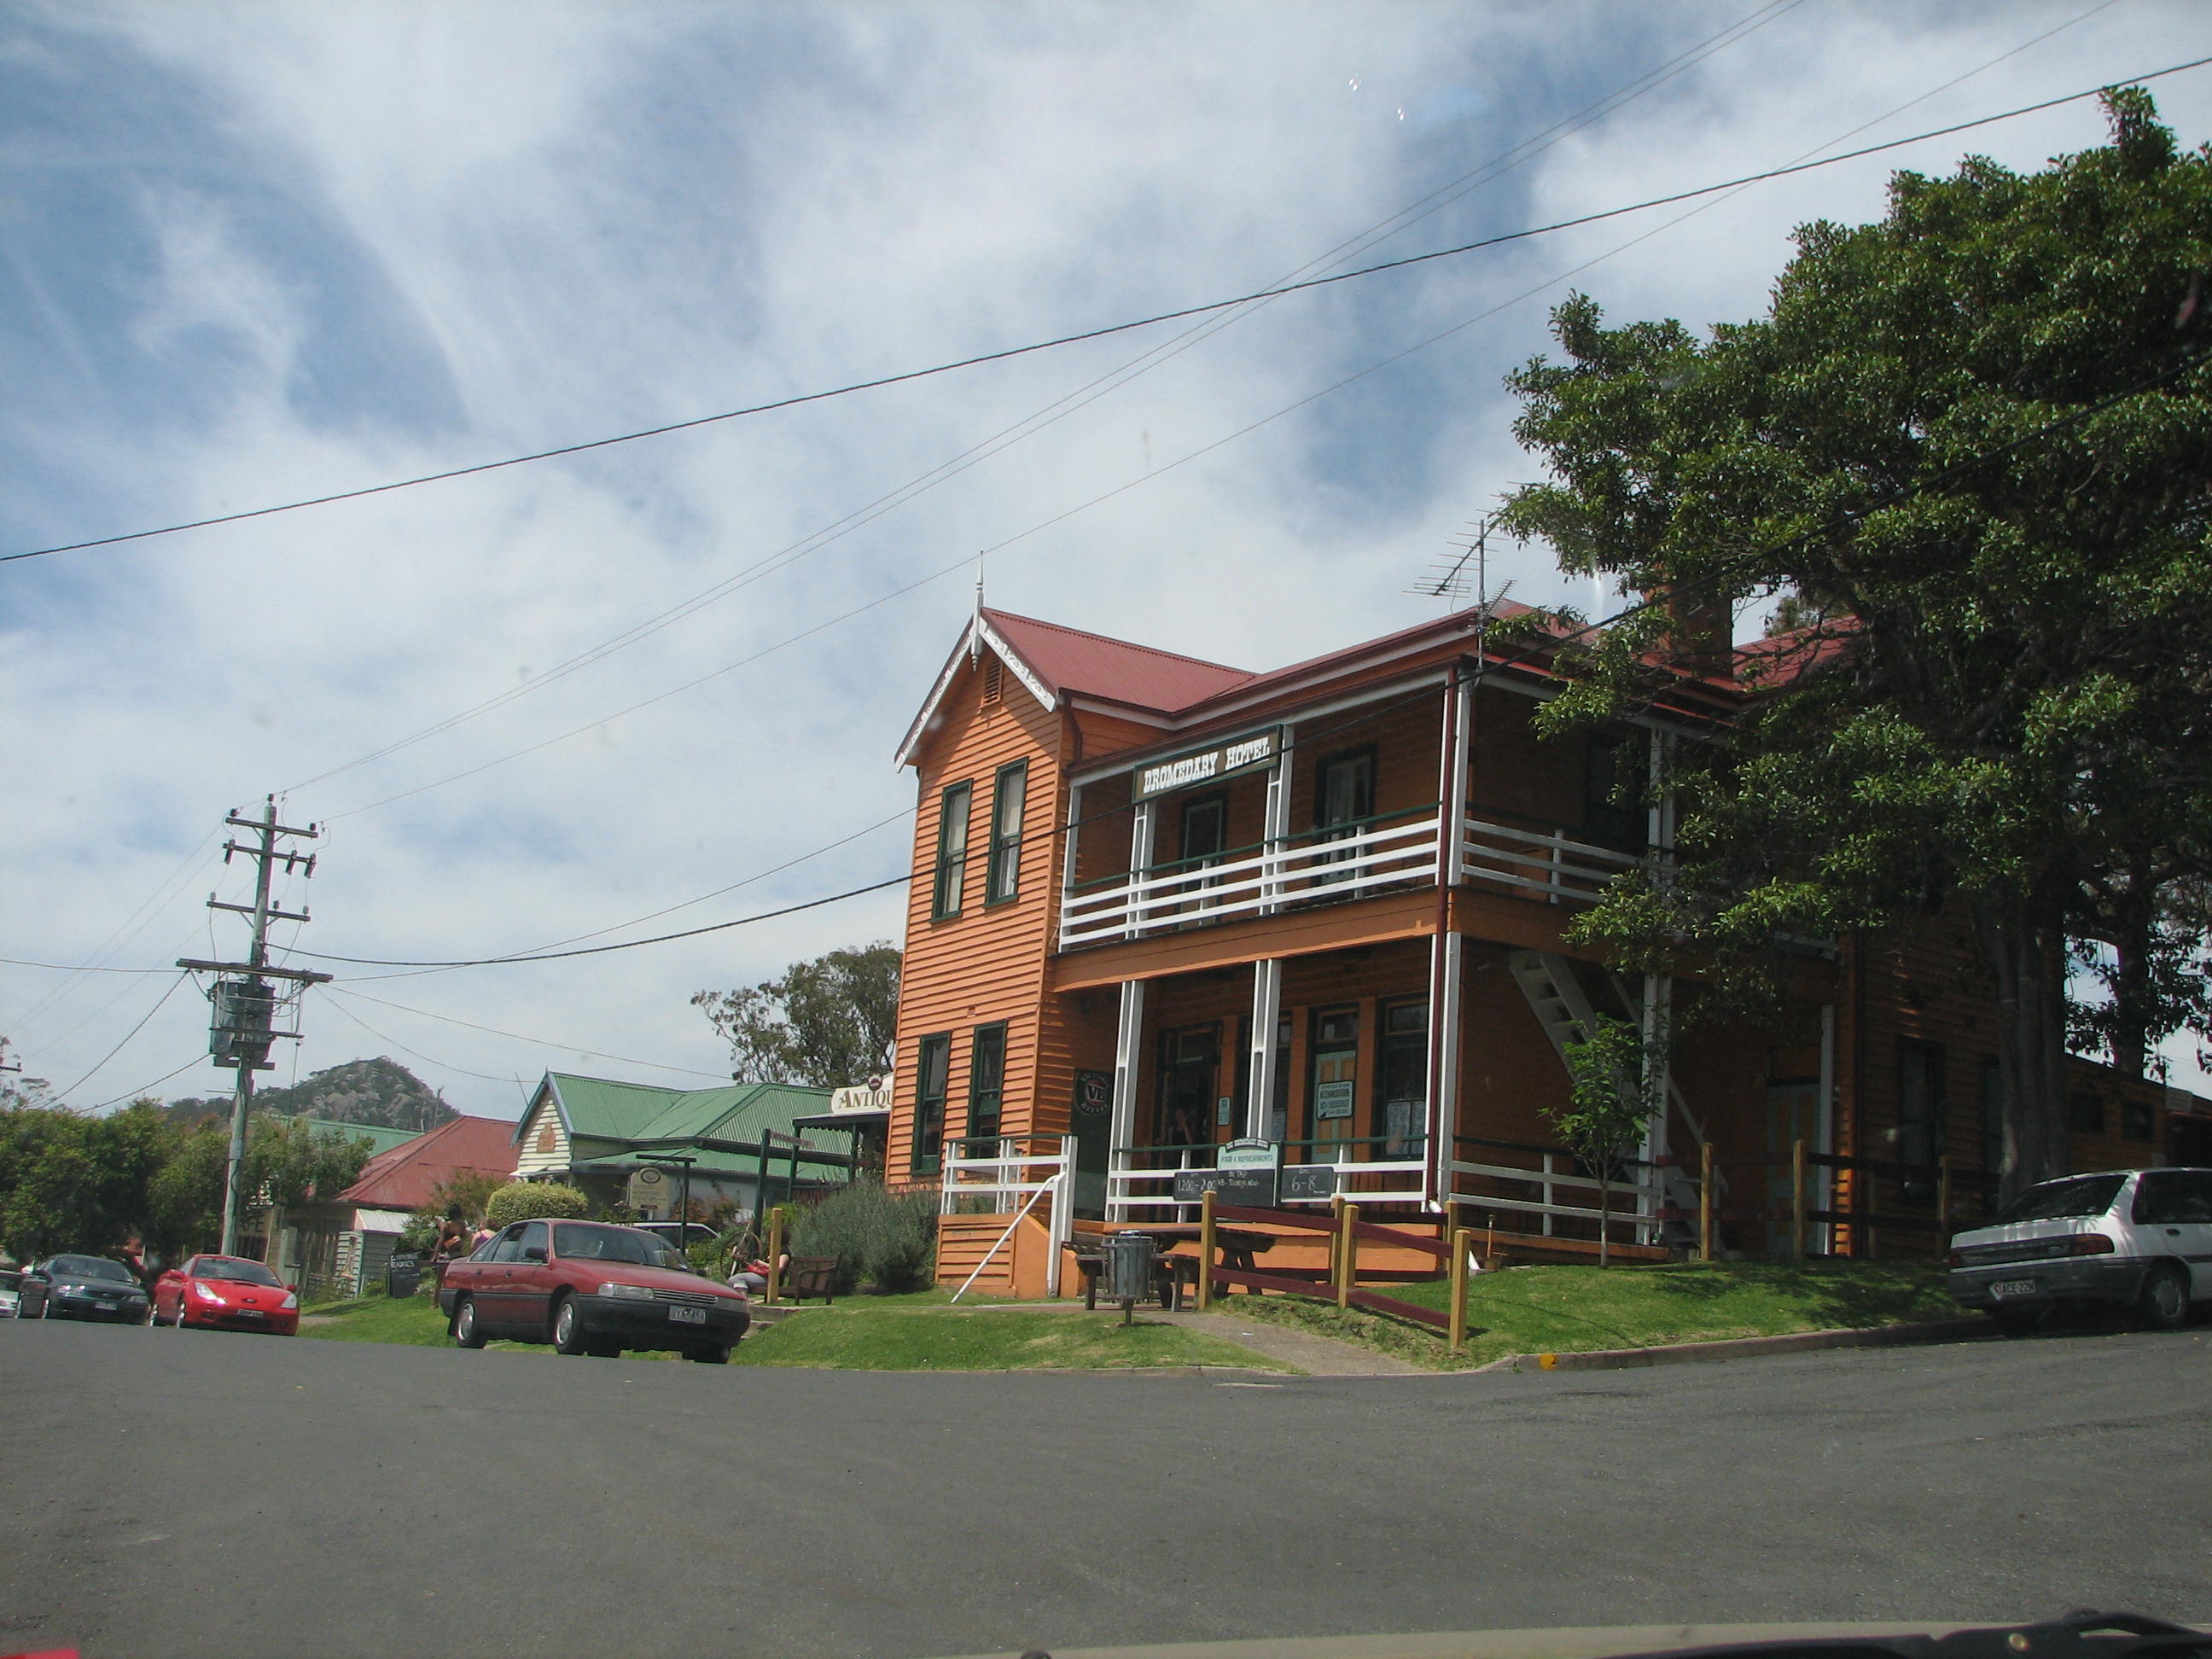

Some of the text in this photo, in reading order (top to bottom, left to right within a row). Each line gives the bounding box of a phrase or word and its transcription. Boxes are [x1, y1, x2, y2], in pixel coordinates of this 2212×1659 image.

[1143, 736, 1271, 794] DROMEDARY HOTEL
[1086, 1085, 1107, 1101] VB
